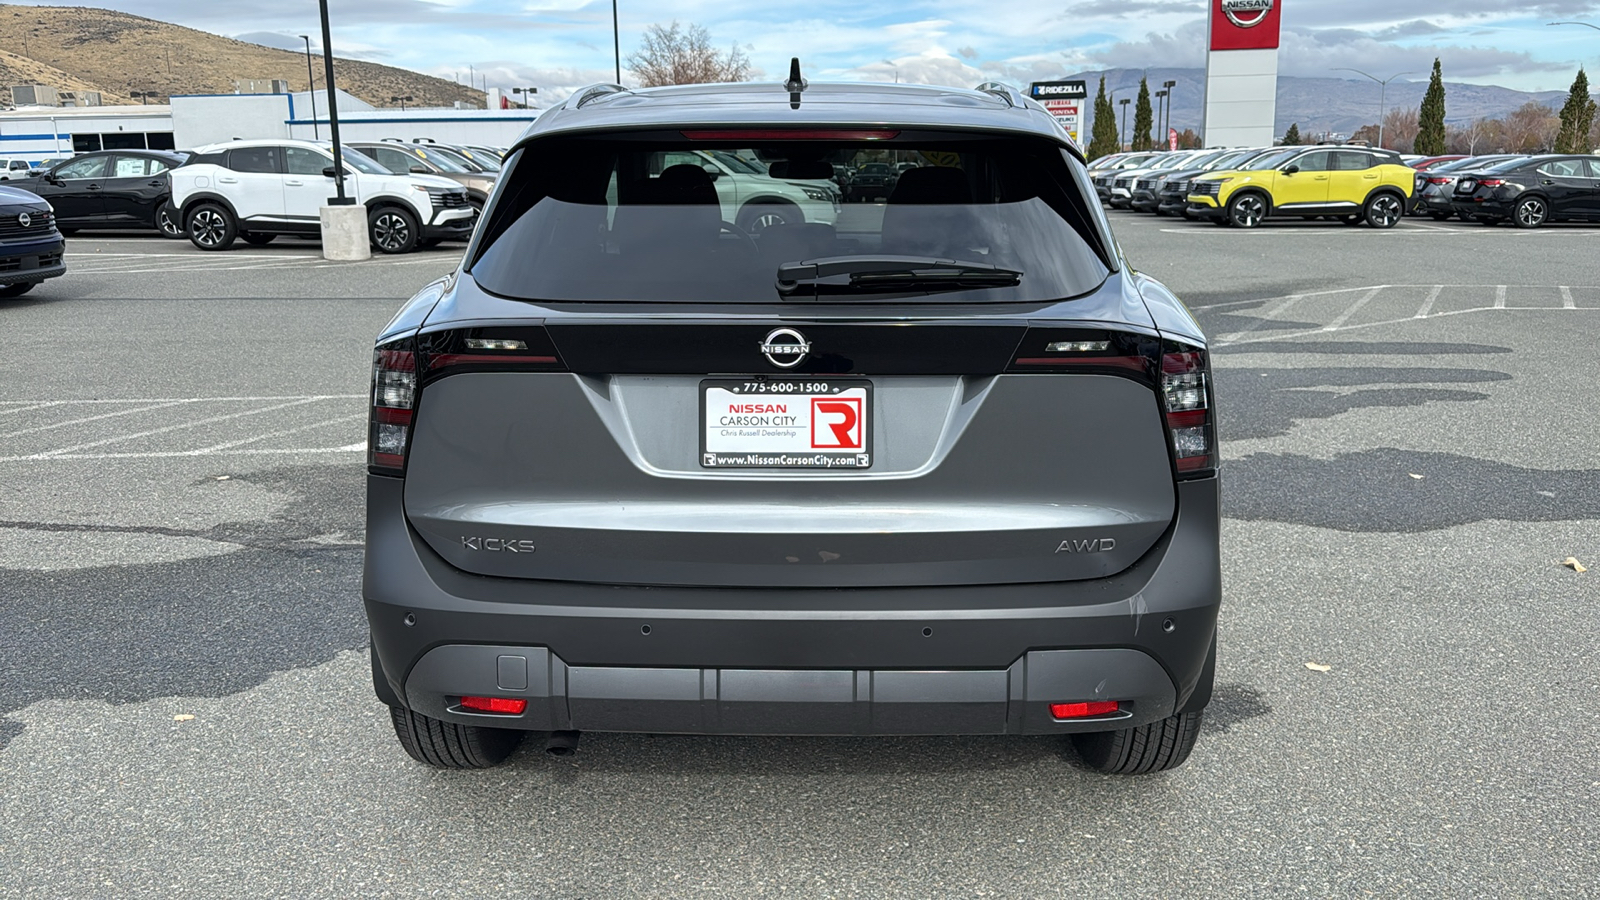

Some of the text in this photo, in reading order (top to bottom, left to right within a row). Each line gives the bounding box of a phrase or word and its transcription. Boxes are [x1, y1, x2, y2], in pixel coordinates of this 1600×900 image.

[1227, 0, 1269, 8] NISSAN
[1045, 85, 1084, 94] RIDEZILLA
[743, 383, 828, 392] 775-600-1500
[729, 404, 787, 413] NISSAN
[720, 416, 796, 426] CARSON CITY
[762, 429, 796, 438] Dealership
[717, 454, 856, 468] www.NissanCarsonCity.com
[461, 536, 535, 553] KICKS
[1054, 538, 1116, 554] AWD
